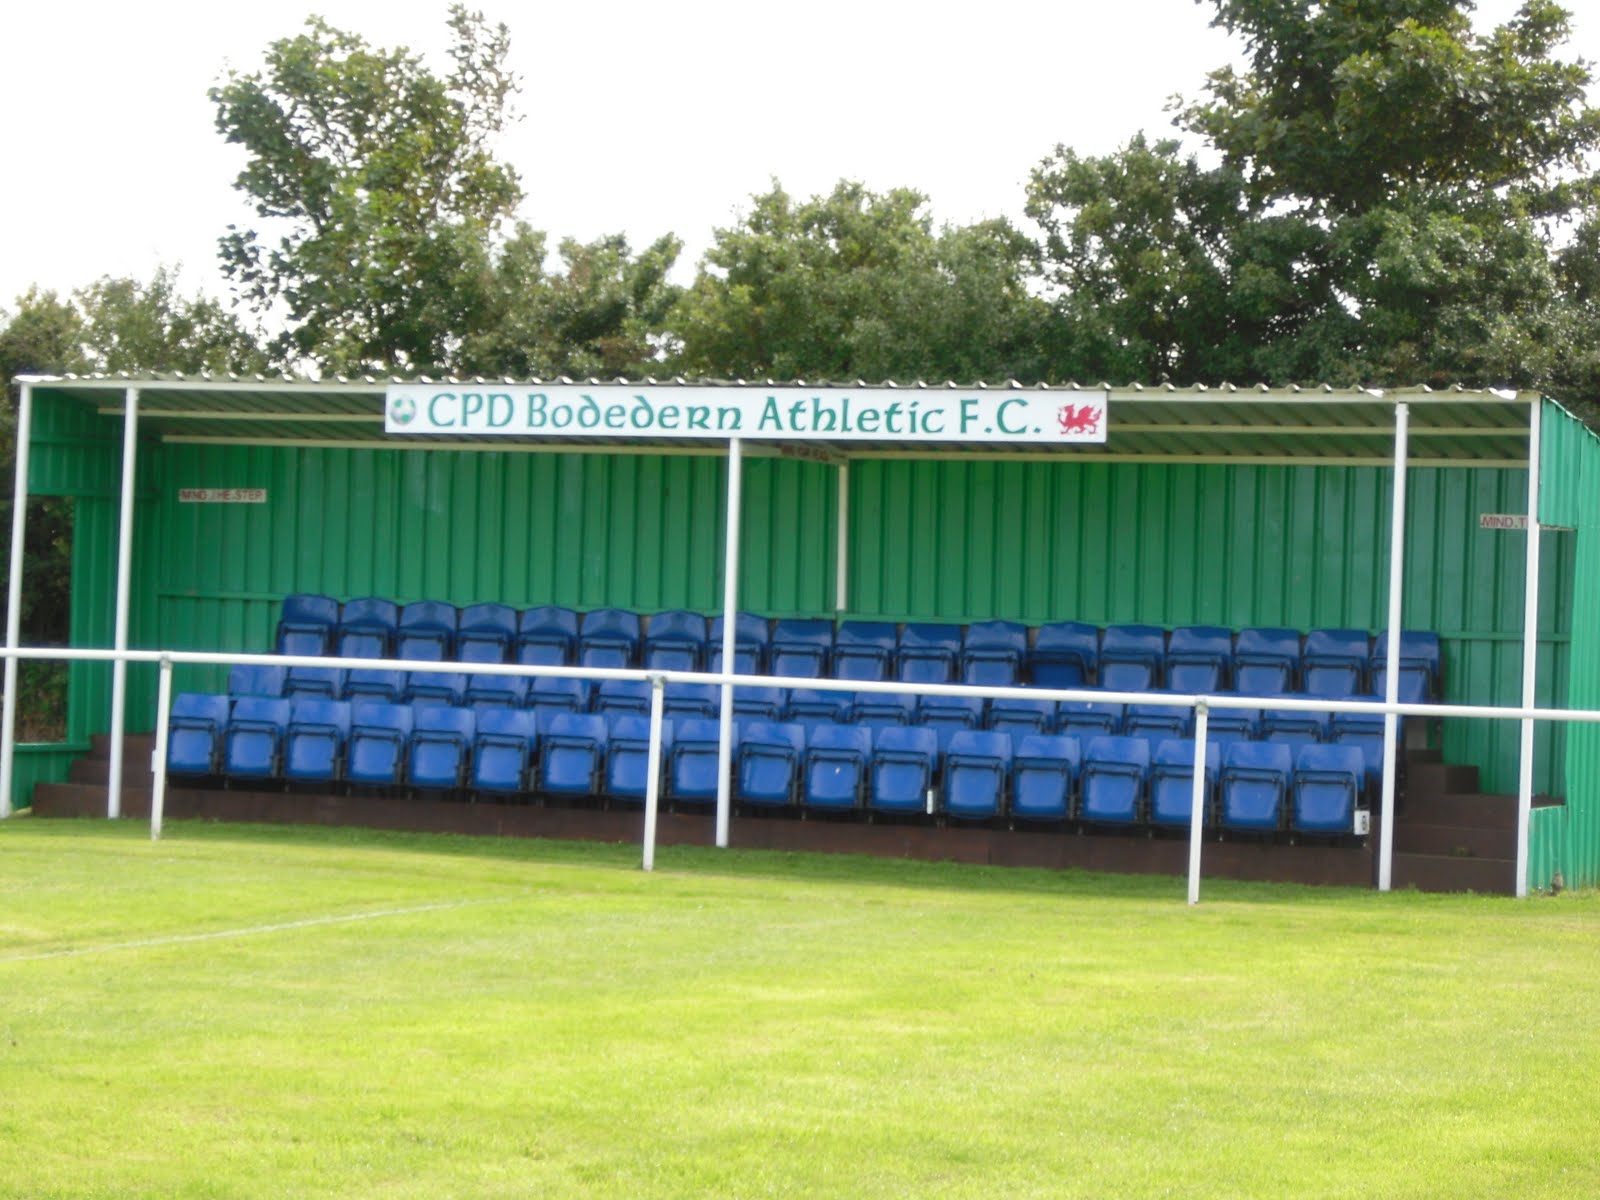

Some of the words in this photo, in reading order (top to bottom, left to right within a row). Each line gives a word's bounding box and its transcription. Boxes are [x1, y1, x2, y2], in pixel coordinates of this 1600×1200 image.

[428, 393, 515, 428] CPD
[526, 393, 743, 431] Bodedern
[758, 396, 945, 434] Athletic
[959, 398, 1042, 435] F.C.
